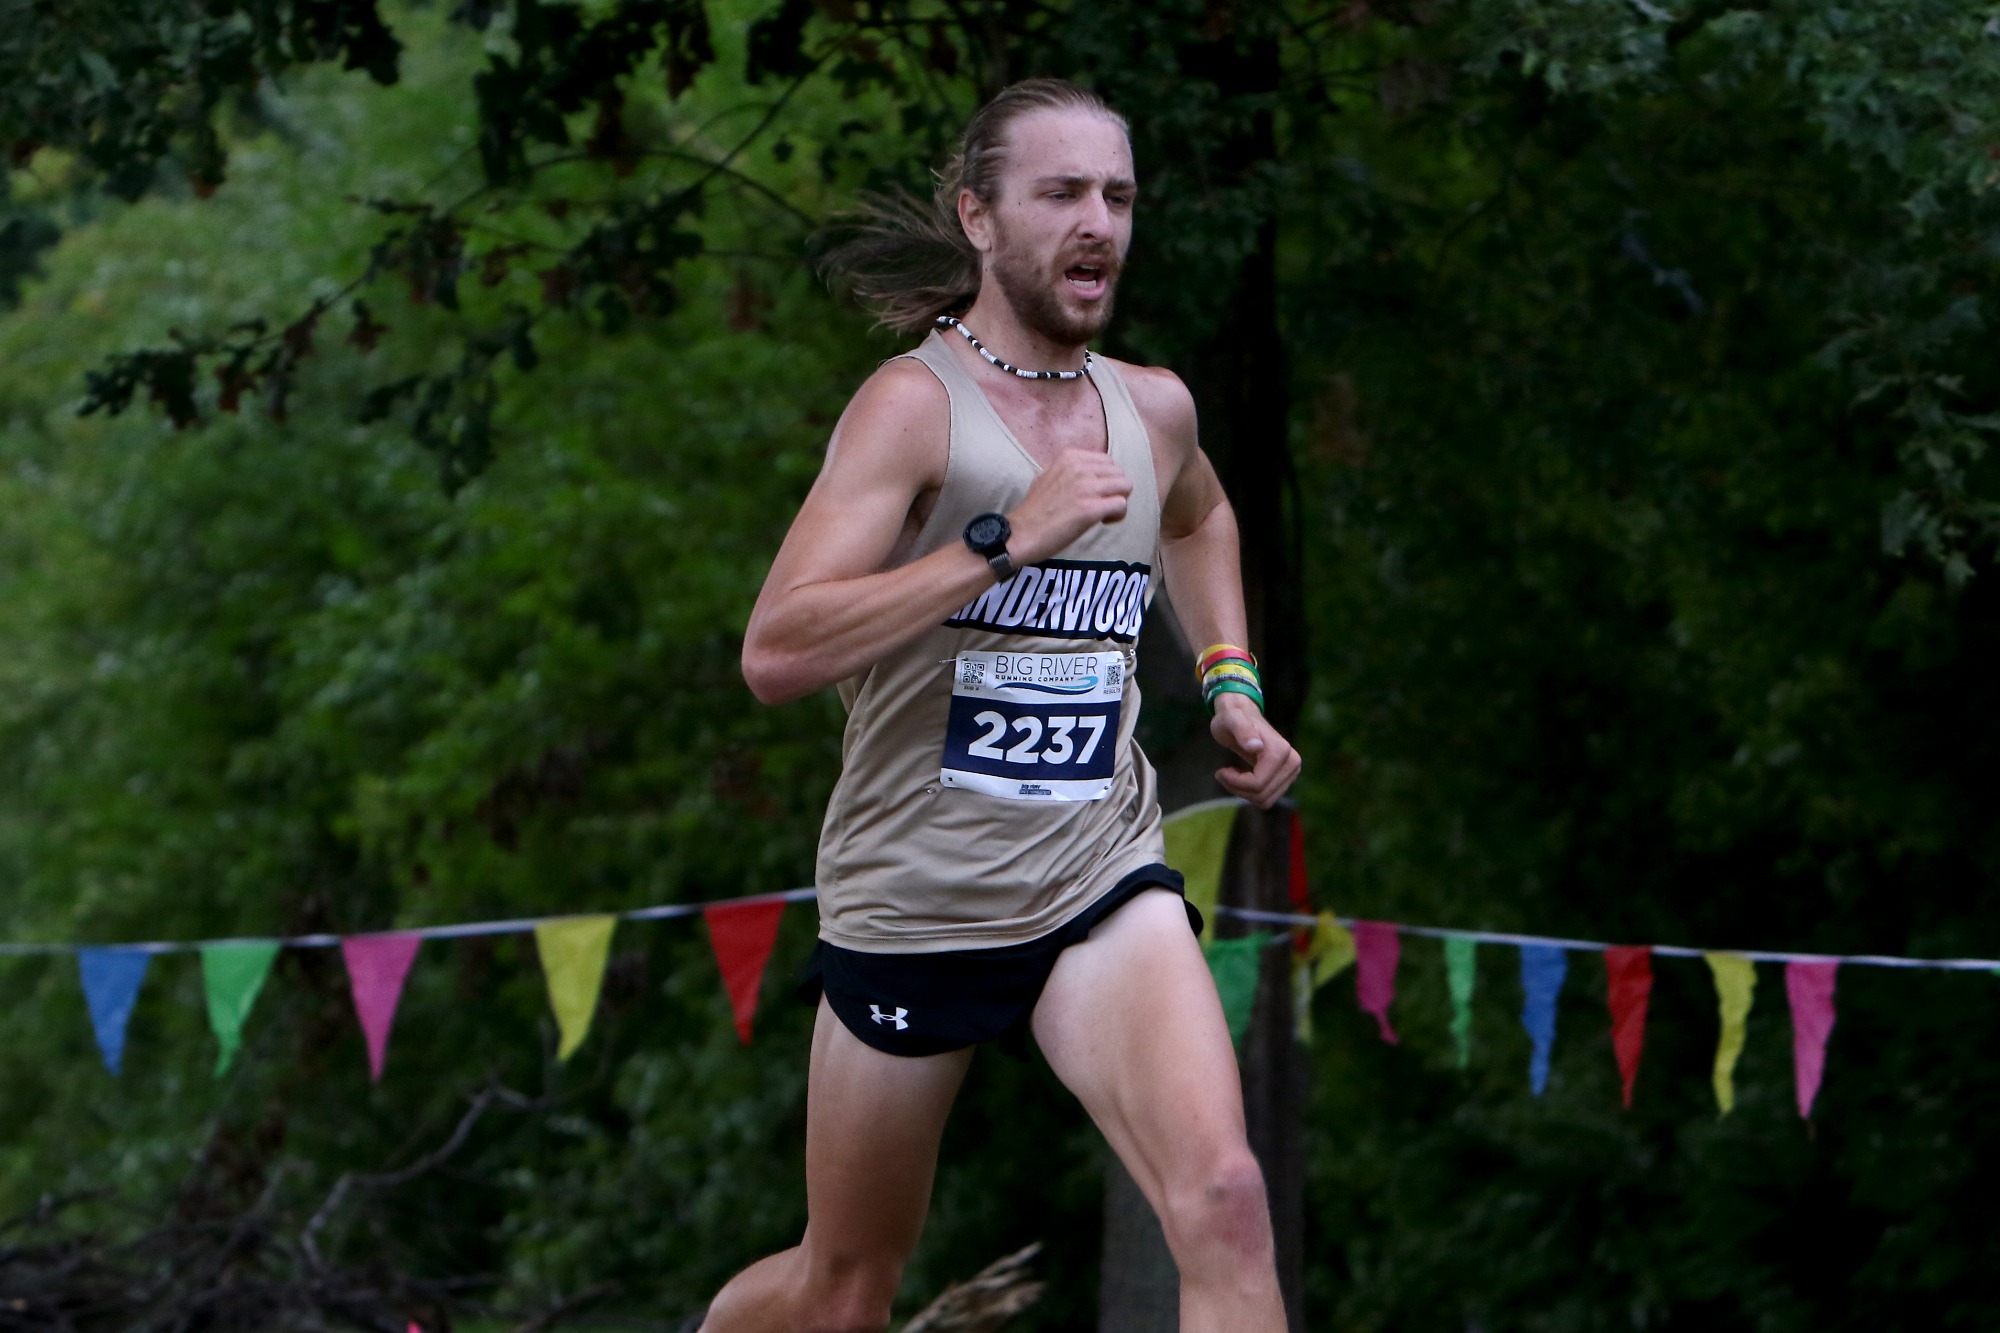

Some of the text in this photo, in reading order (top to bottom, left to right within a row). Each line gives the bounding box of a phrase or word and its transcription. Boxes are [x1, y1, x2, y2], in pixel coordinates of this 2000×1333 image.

[995, 655, 1098, 676] BIG RIVER
[995, 674, 1034, 682] RUNNING
[967, 710, 1107, 765] 2237
